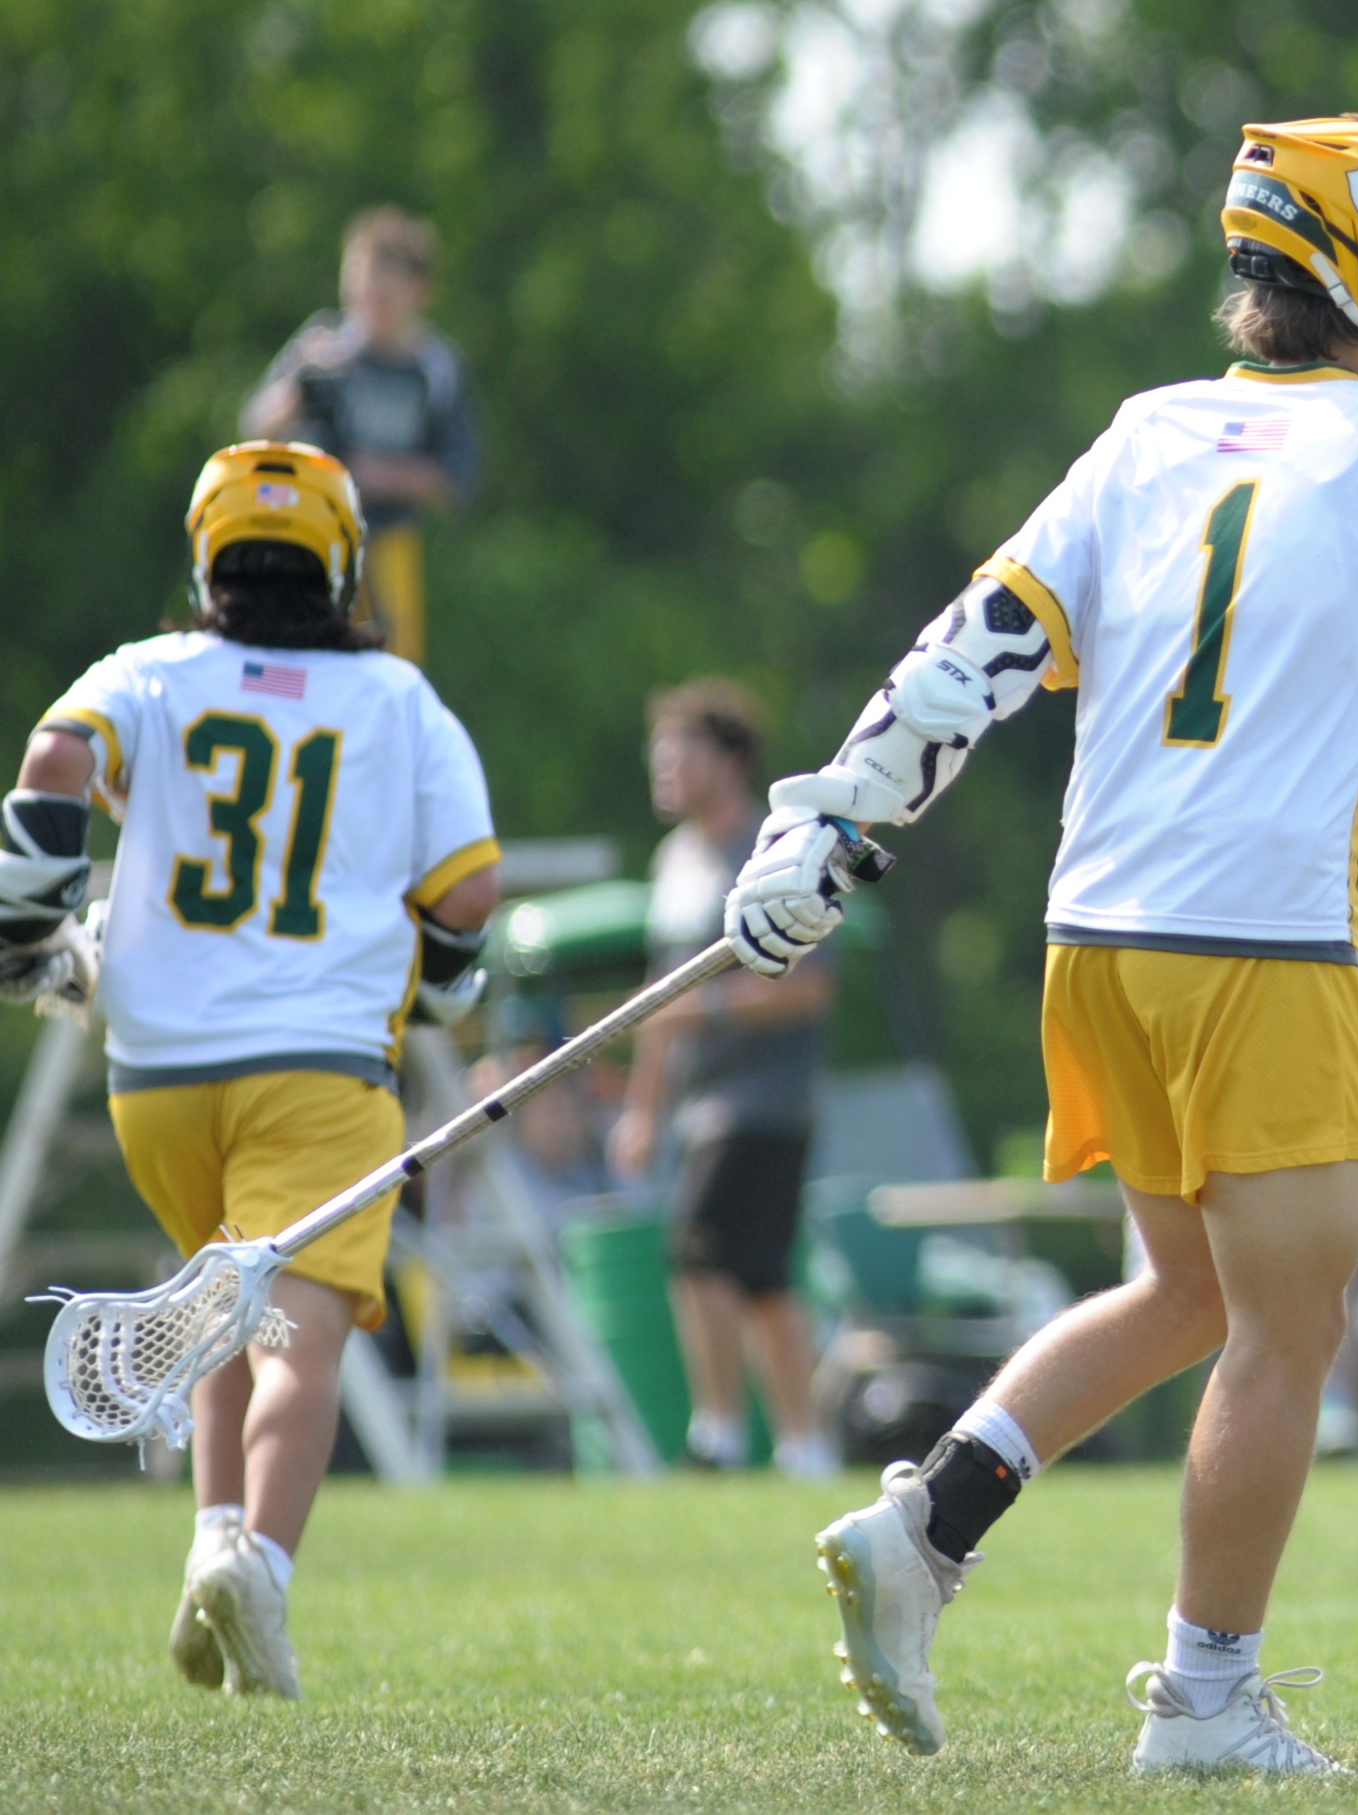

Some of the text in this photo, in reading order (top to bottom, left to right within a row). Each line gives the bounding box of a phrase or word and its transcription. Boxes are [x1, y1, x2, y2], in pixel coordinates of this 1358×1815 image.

[1231, 182, 1298, 221] NEERS
[1160, 476, 1262, 749] 1
[935, 659, 973, 687] STX
[167, 708, 343, 942] 31
[1196, 1641, 1241, 1655] adidas
